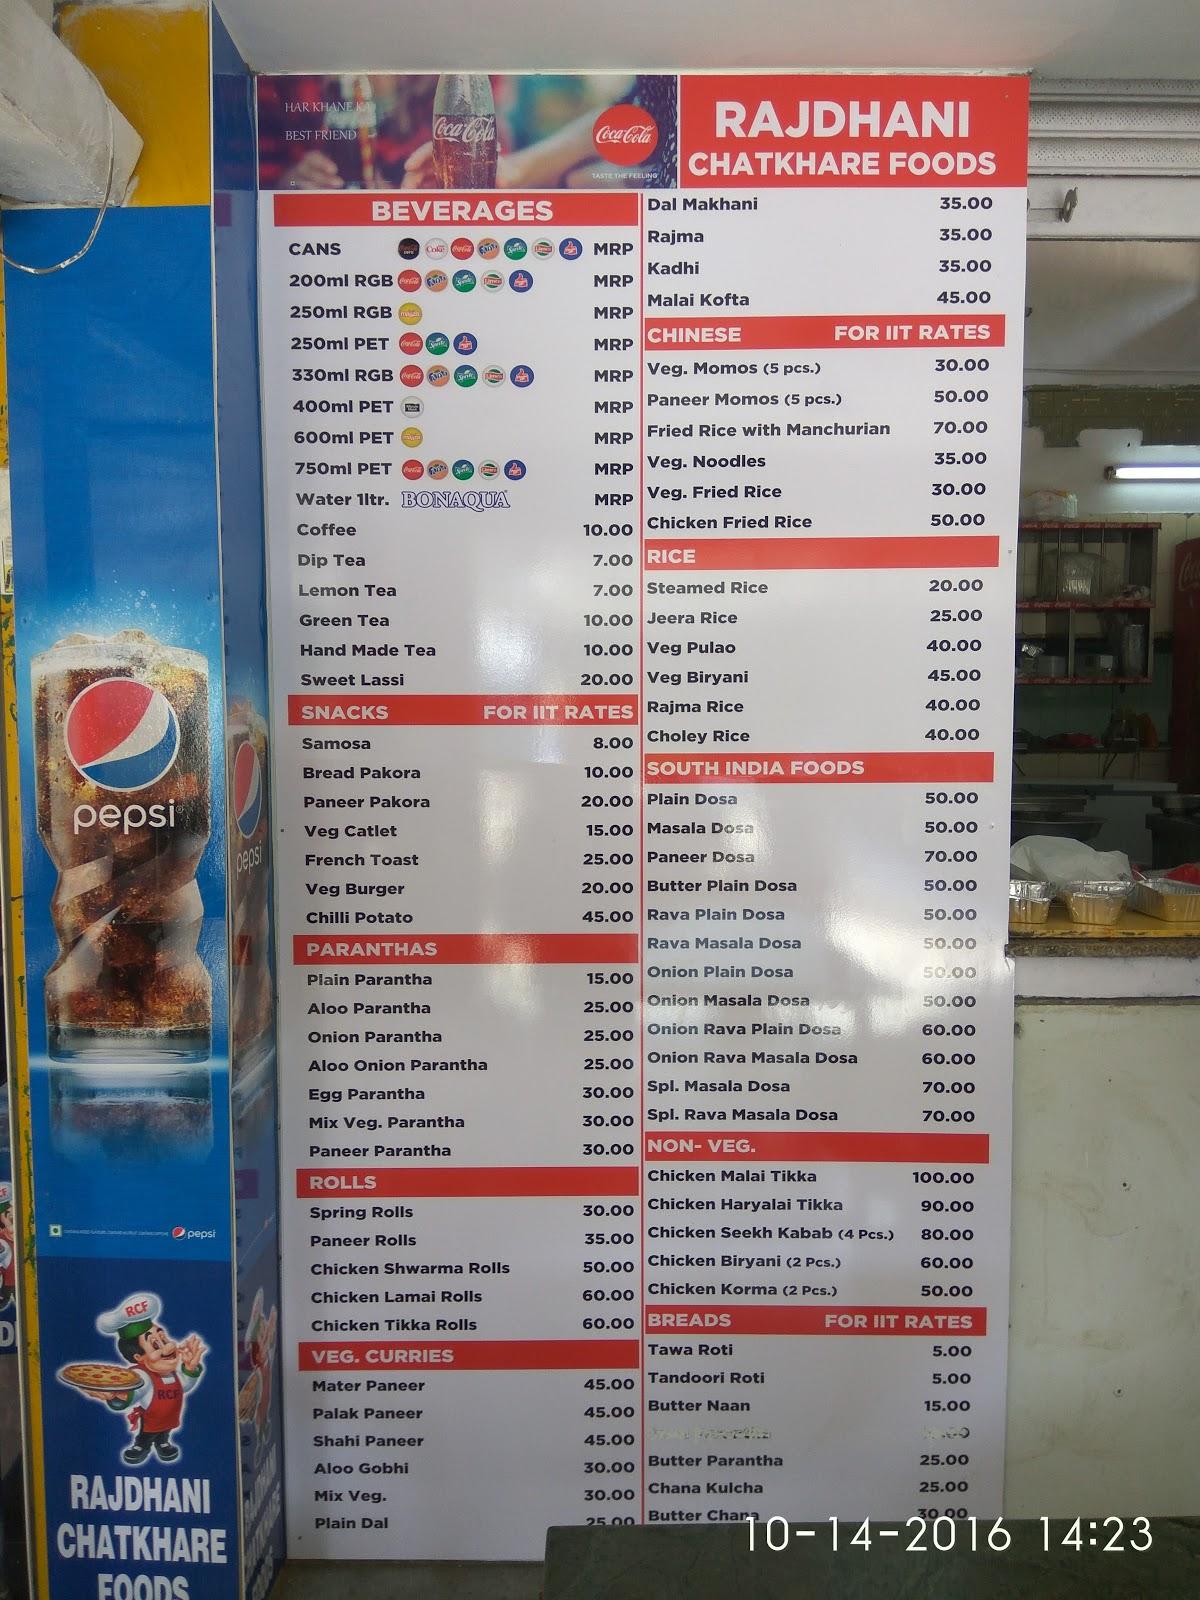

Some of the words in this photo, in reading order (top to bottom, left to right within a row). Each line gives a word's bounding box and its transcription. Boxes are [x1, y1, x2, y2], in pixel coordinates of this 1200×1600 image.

[286, 102, 309, 112] HAR
[312, 101, 353, 112] KHANE
[714, 100, 970, 138] RAJDHANI
[285, 130, 312, 141] BEST
[315, 130, 357, 141] FRIEND
[688, 152, 880, 176] CHATKHARE
[889, 151, 997, 175] FOODS
[372, 200, 554, 222] BEVERAGES
[647, 197, 677, 212] Dal
[682, 196, 758, 211] Makhani
[939, 196, 993, 210] 35.00
[288, 242, 342, 256] CANS
[593, 242, 634, 256] MRP
[647, 261, 700, 276] Kadhi
[938, 259, 992, 273] 35.00
[289, 273, 349, 288] 200ml
[354, 273, 394, 288] RGB
[593, 274, 634, 288] MRP
[646, 326, 742, 344] CHINESE
[834, 325, 880, 341] FOR
[885, 324, 913, 341] IIT
[918, 324, 991, 340] RATES
[290, 336, 349, 351] 250ml
[354, 337, 390, 351] PET
[593, 338, 634, 352] MRP
[292, 368, 350, 382] 330ml
[354, 368, 394, 382] RGB
[594, 369, 634, 383] MRP
[646, 362, 688, 378] Veg.
[693, 361, 758, 375] Momos
[762, 362, 779, 376] (5
[783, 362, 821, 376] pcs.)
[934, 358, 990, 372] 30.00
[647, 423, 694, 438] Fried
[698, 423, 737, 438] Rice
[741, 423, 781, 437] with
[786, 421, 891, 436] Manchurian
[933, 420, 988, 435] 70.00
[295, 492, 353, 506] Water
[356, 492, 390, 506] 1ltr.
[401, 490, 510, 512] BONAQUA
[594, 493, 634, 506] MRP
[296, 522, 357, 537] Coffee
[583, 523, 634, 537] 10.00
[647, 548, 696, 564] RICE
[298, 583, 360, 597] Lemon
[363, 584, 397, 597] Tea
[593, 583, 634, 597] 7.00
[300, 673, 356, 687] Sweet
[360, 673, 405, 687] Lassi
[580, 673, 634, 686] 20.00
[646, 671, 682, 686] Veg
[687, 670, 749, 686] Biryani
[927, 668, 982, 682] 45.00
[301, 705, 389, 720] SNACKS
[483, 705, 527, 720] FOR
[532, 705, 560, 721] IIT
[564, 704, 634, 720] RATES
[301, 737, 372, 750] Samosa
[593, 736, 634, 750] 8.00
[646, 761, 720, 776] SOUTH
[725, 760, 785, 776] INDIA
[790, 760, 865, 776] FOODS
[303, 796, 365, 809] Paneer
[369, 795, 431, 809] Pakora
[580, 795, 634, 808] 20.00
[647, 792, 690, 806] Plain
[694, 793, 738, 806] Dosa
[924, 791, 979, 805] 50.00
[73, 798, 175, 835] pepsi
[236, 839, 262, 881] pepsi
[305, 853, 366, 867] French
[369, 853, 419, 866] Toast
[582, 853, 634, 866] 25.00
[306, 941, 438, 957] PARANTHAS
[647, 937, 690, 950] Rava
[695, 936, 754, 950] Masala
[758, 937, 802, 950] Dosa
[923, 936, 977, 950] 50.00
[308, 1088, 343, 1103] Egg
[347, 1087, 425, 1101] Parantha
[582, 1086, 635, 1099] 30.00
[647, 1079, 680, 1095] Spl.
[684, 1079, 743, 1093] Masala
[747, 1080, 791, 1093] Dosa
[922, 1081, 976, 1094] 70.00
[647, 1138, 702, 1153] NON-
[707, 1138, 756, 1153] VEG.
[309, 1175, 377, 1190] ROLLS
[647, 1169, 716, 1182] Chicken
[720, 1169, 766, 1182] Malai
[770, 1169, 817, 1183] Tikka
[912, 1171, 975, 1185] 100.00
[309, 1206, 367, 1221] Spring
[371, 1205, 414, 1219] Rolls
[582, 1204, 635, 1217] 30.00
[187, 1229, 216, 1239] pepsi
[647, 1225, 716, 1239] Chicken
[720, 1226, 773, 1239] Seekh
[777, 1226, 833, 1240] Kabab
[837, 1229, 855, 1241] (4
[858, 1229, 895, 1242] Pcs.)
[921, 1228, 974, 1241] 80.00
[310, 1262, 380, 1276] Chicken
[383, 1262, 464, 1275] Shwarma
[468, 1261, 510, 1275] Rolls
[582, 1261, 635, 1274] 50.00
[125, 1301, 148, 1317] RCF
[647, 1313, 732, 1328] BREADS
[824, 1313, 868, 1329] FOR
[873, 1314, 900, 1329] IIT
[904, 1314, 973, 1329] RATES
[311, 1349, 360, 1364] VEG.
[364, 1348, 454, 1364] CURRIES
[312, 1380, 362, 1392] Mater
[365, 1379, 426, 1392] Paneer
[583, 1378, 635, 1391] 45.00
[647, 1371, 725, 1384] Tandoori
[729, 1371, 765, 1384] Roti
[932, 1372, 972, 1385] 5.00
[158, 1389, 180, 1400] RCF
[313, 1462, 354, 1475] Aloo
[358, 1461, 409, 1475] Gobhi
[583, 1461, 635, 1474] 30.00
[69, 1474, 211, 1514] RAJDHANI
[647, 1481, 701, 1495] Chana
[705, 1481, 764, 1494] Kulcha
[919, 1480, 969, 1493] 25.00
[56, 1522, 228, 1564] CHATKHARE
[97, 1573, 191, 1600] FOODS
